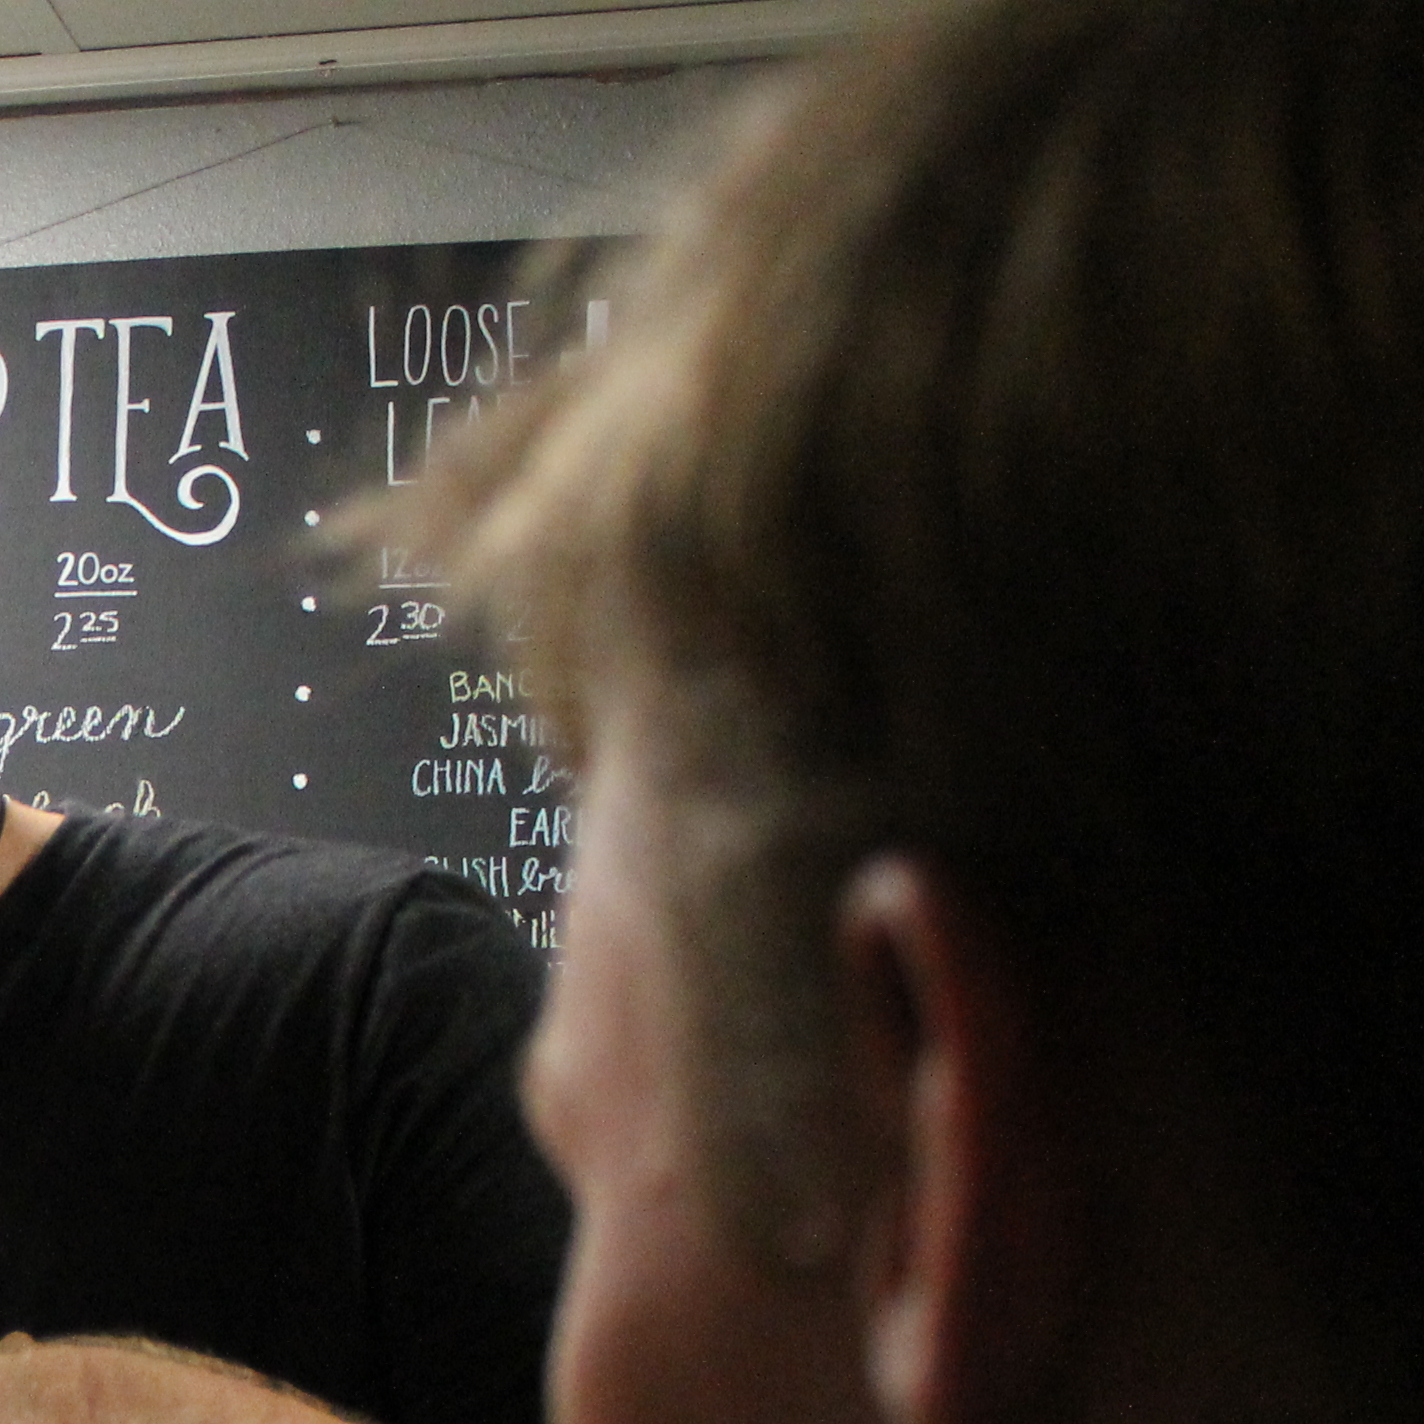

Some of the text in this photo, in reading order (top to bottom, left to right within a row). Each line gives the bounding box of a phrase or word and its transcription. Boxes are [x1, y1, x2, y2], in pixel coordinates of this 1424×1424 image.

[368, 301, 532, 388] LOOSE
[36, 311, 249, 546] TEA
[56, 552, 135, 587] 20oz
[412, 758, 506, 797] CHINA
